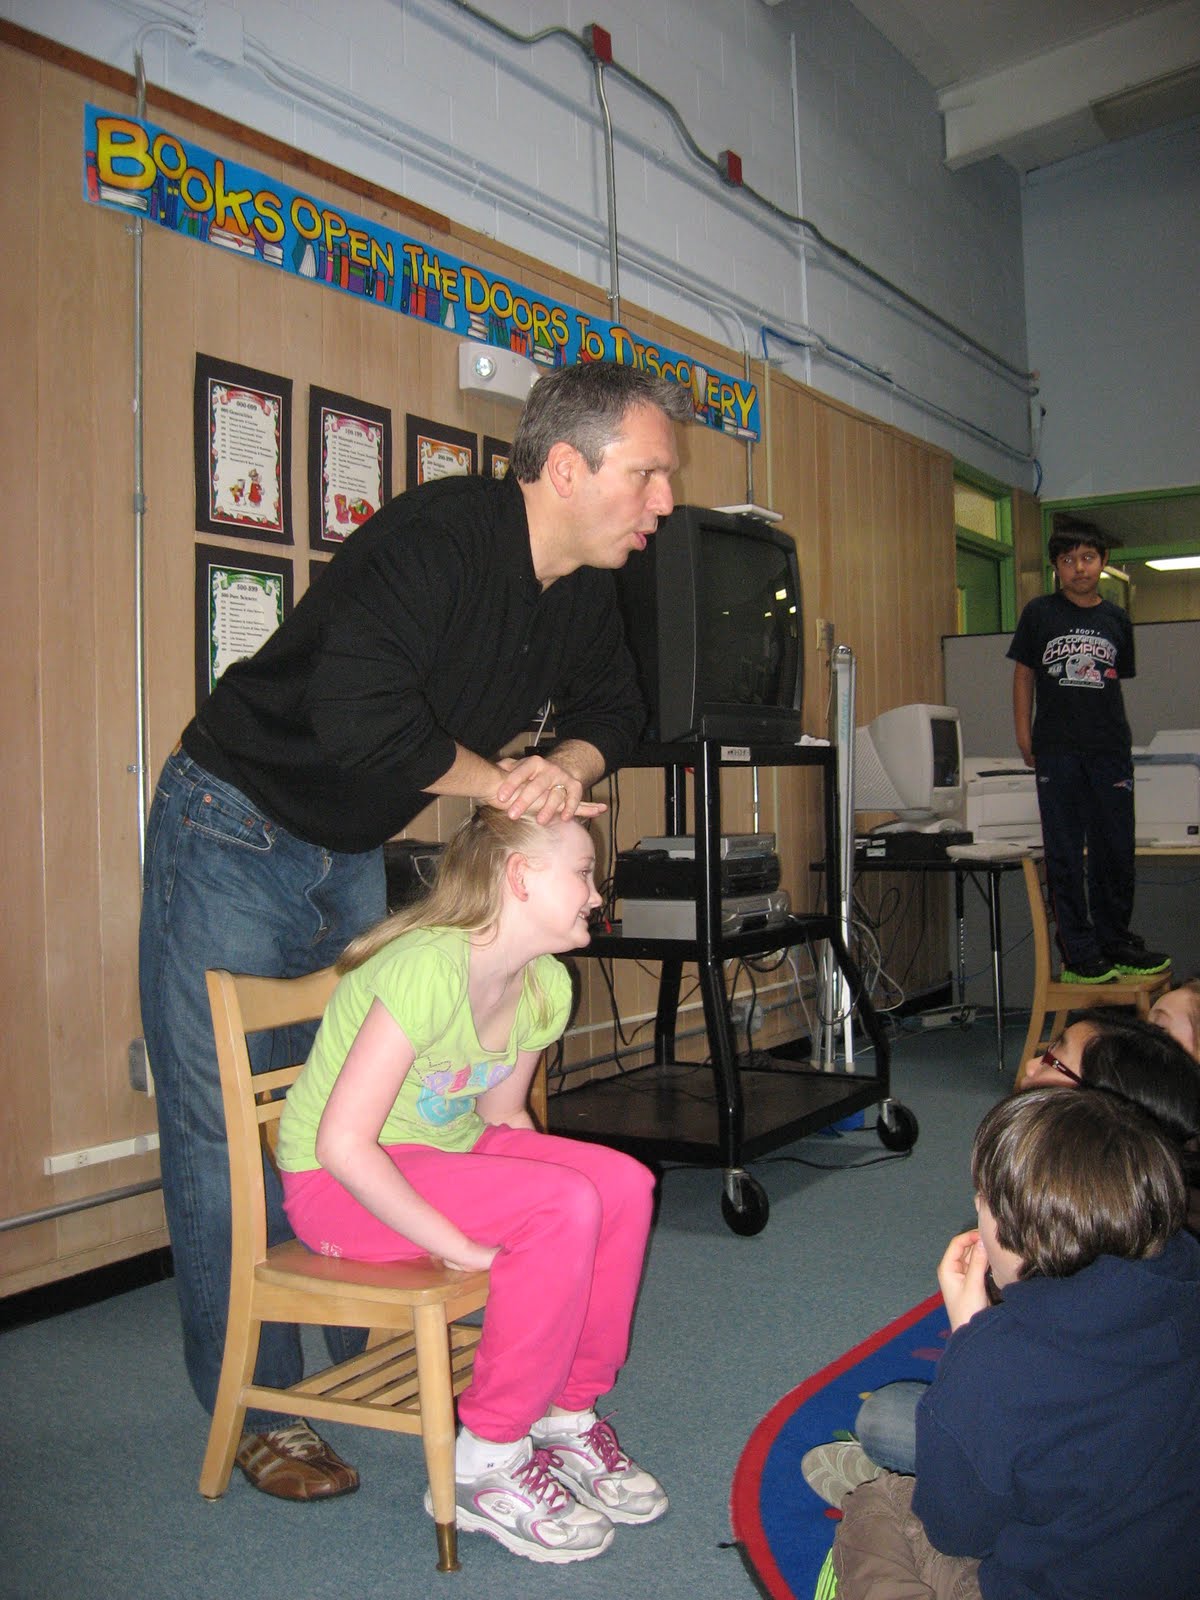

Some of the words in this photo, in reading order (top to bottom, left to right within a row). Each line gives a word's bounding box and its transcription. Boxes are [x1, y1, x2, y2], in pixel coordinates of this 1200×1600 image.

[290, 197, 395, 277] OPEN
[237, 583, 258, 592] 500-599
[1075, 628, 1095, 636] 2007
